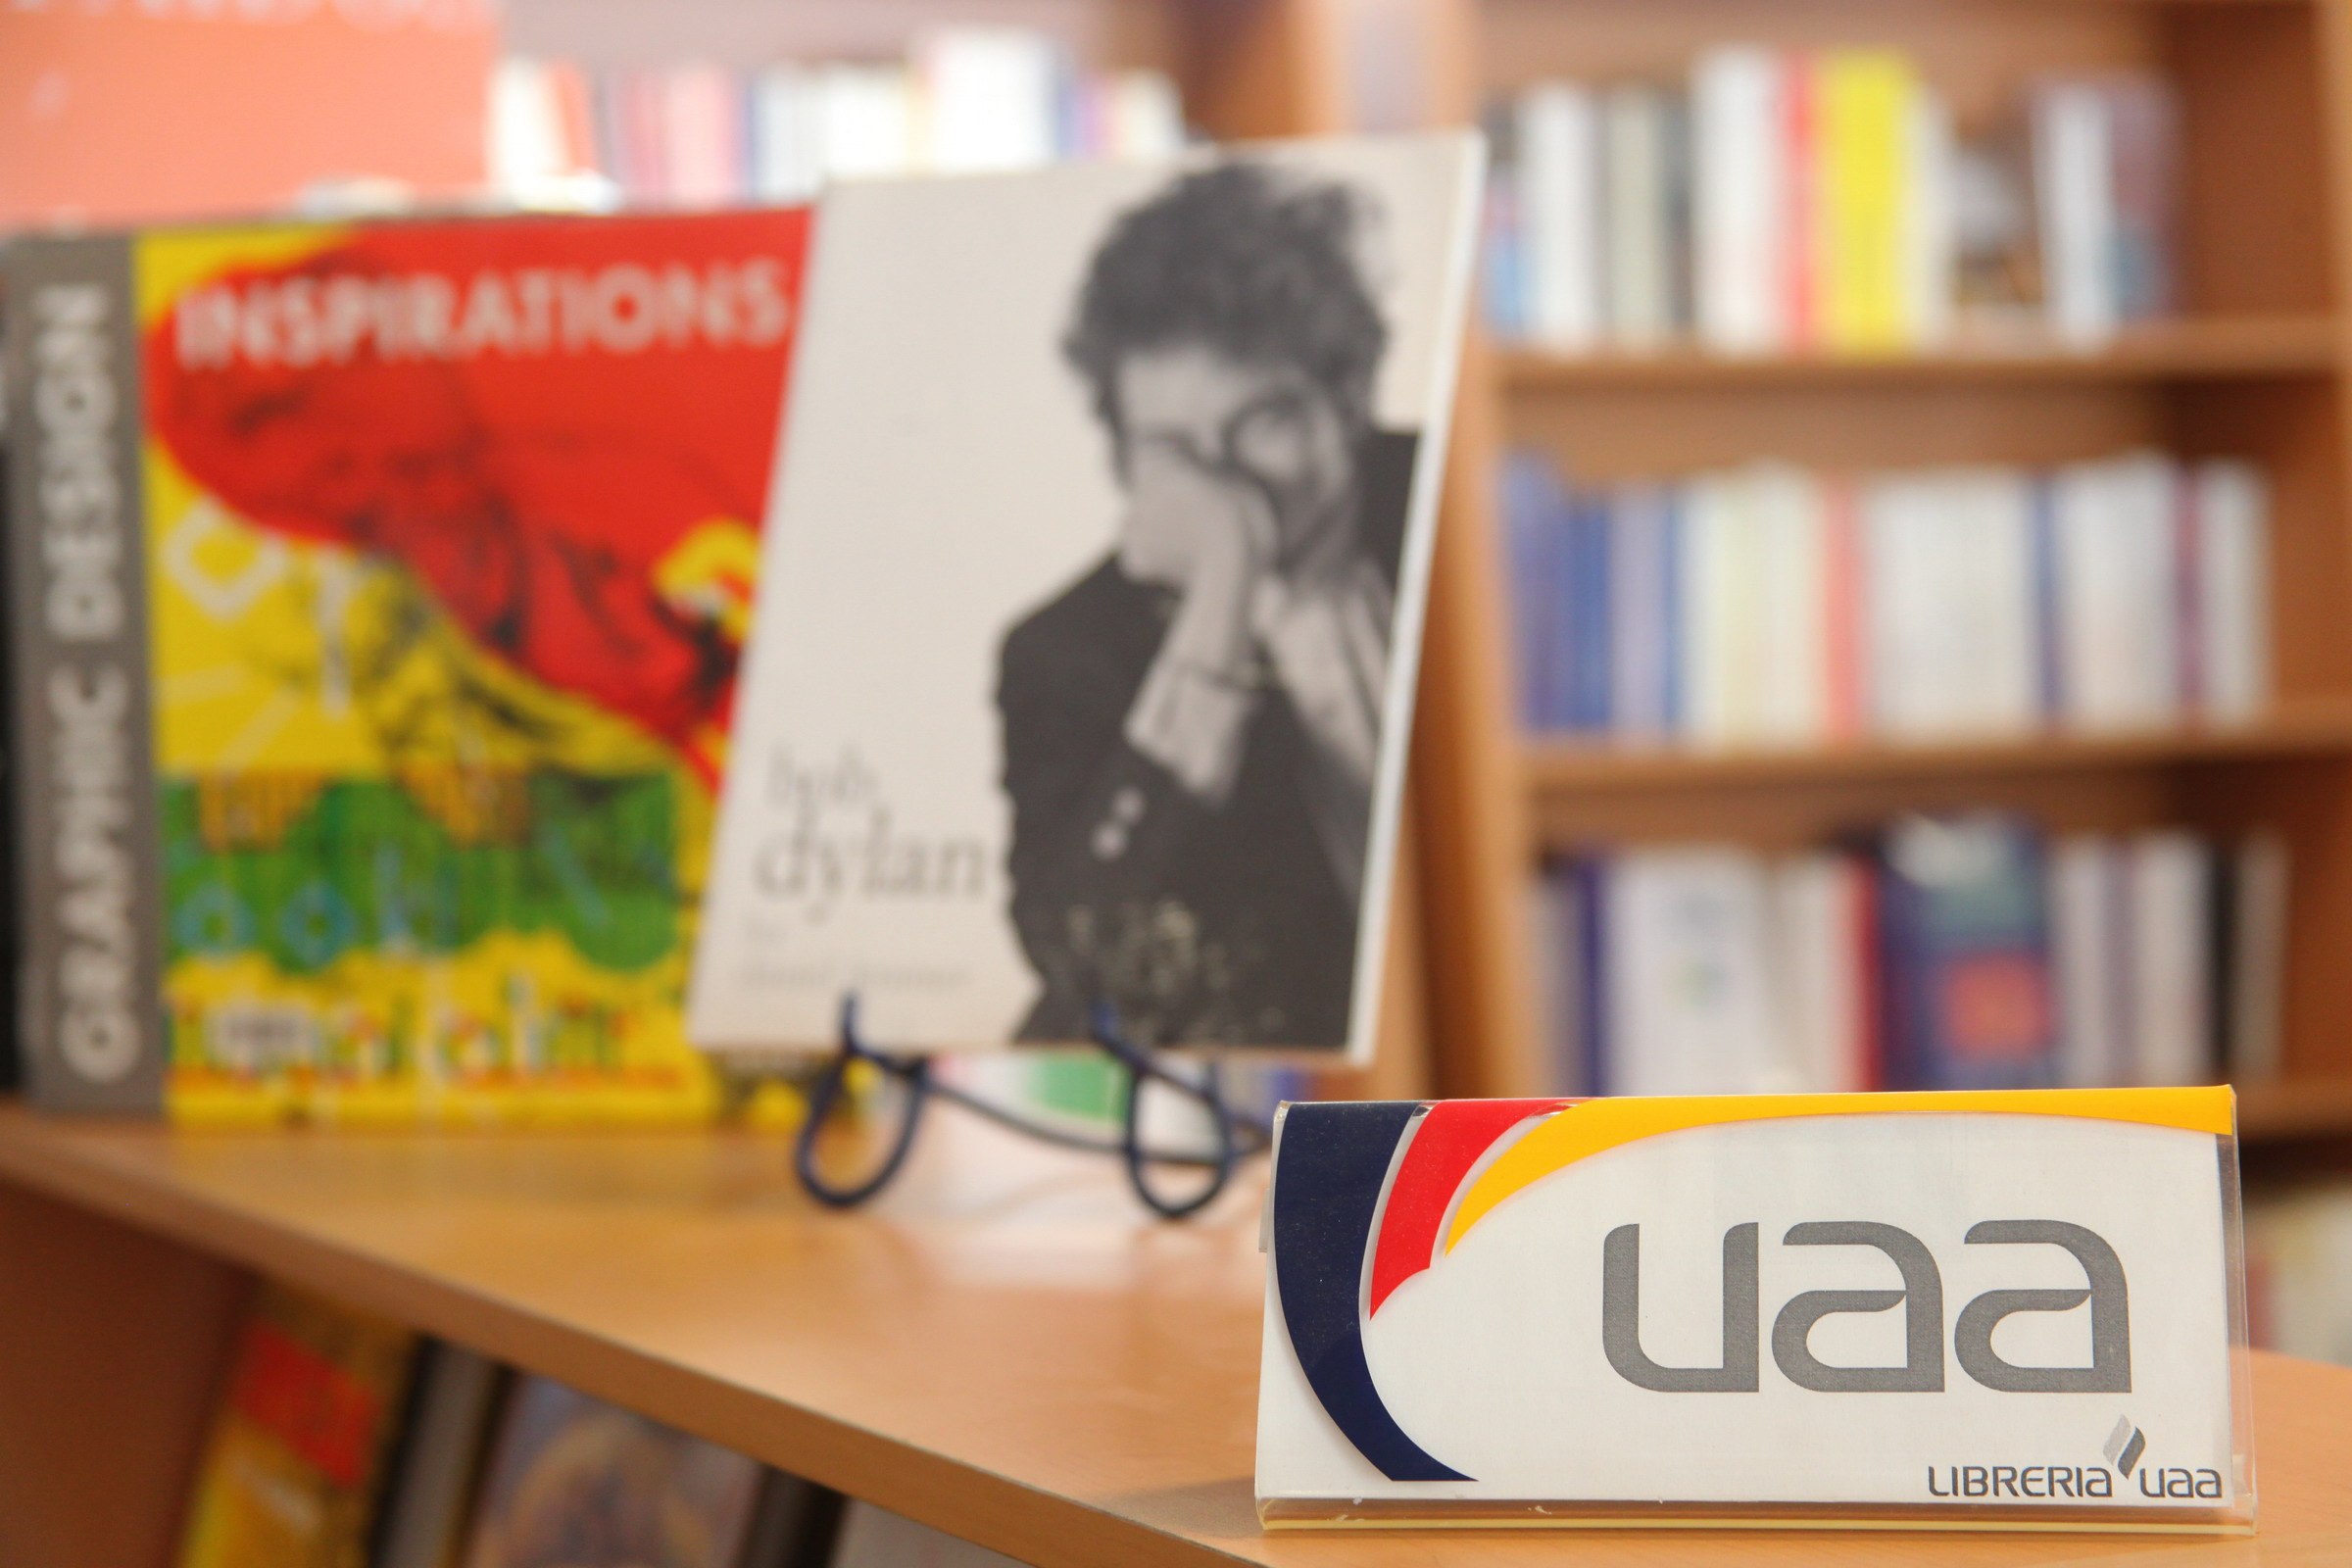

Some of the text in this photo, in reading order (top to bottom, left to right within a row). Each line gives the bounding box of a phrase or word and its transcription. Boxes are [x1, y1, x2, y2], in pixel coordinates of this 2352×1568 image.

[174, 258, 792, 371] INSPIRATIONS
[33, 282, 143, 1083] GRAPHIC DESIGN
[752, 770, 986, 926] dylan
[1602, 1219, 2132, 1393] uaa
[2138, 1467, 2223, 1498] uaa
